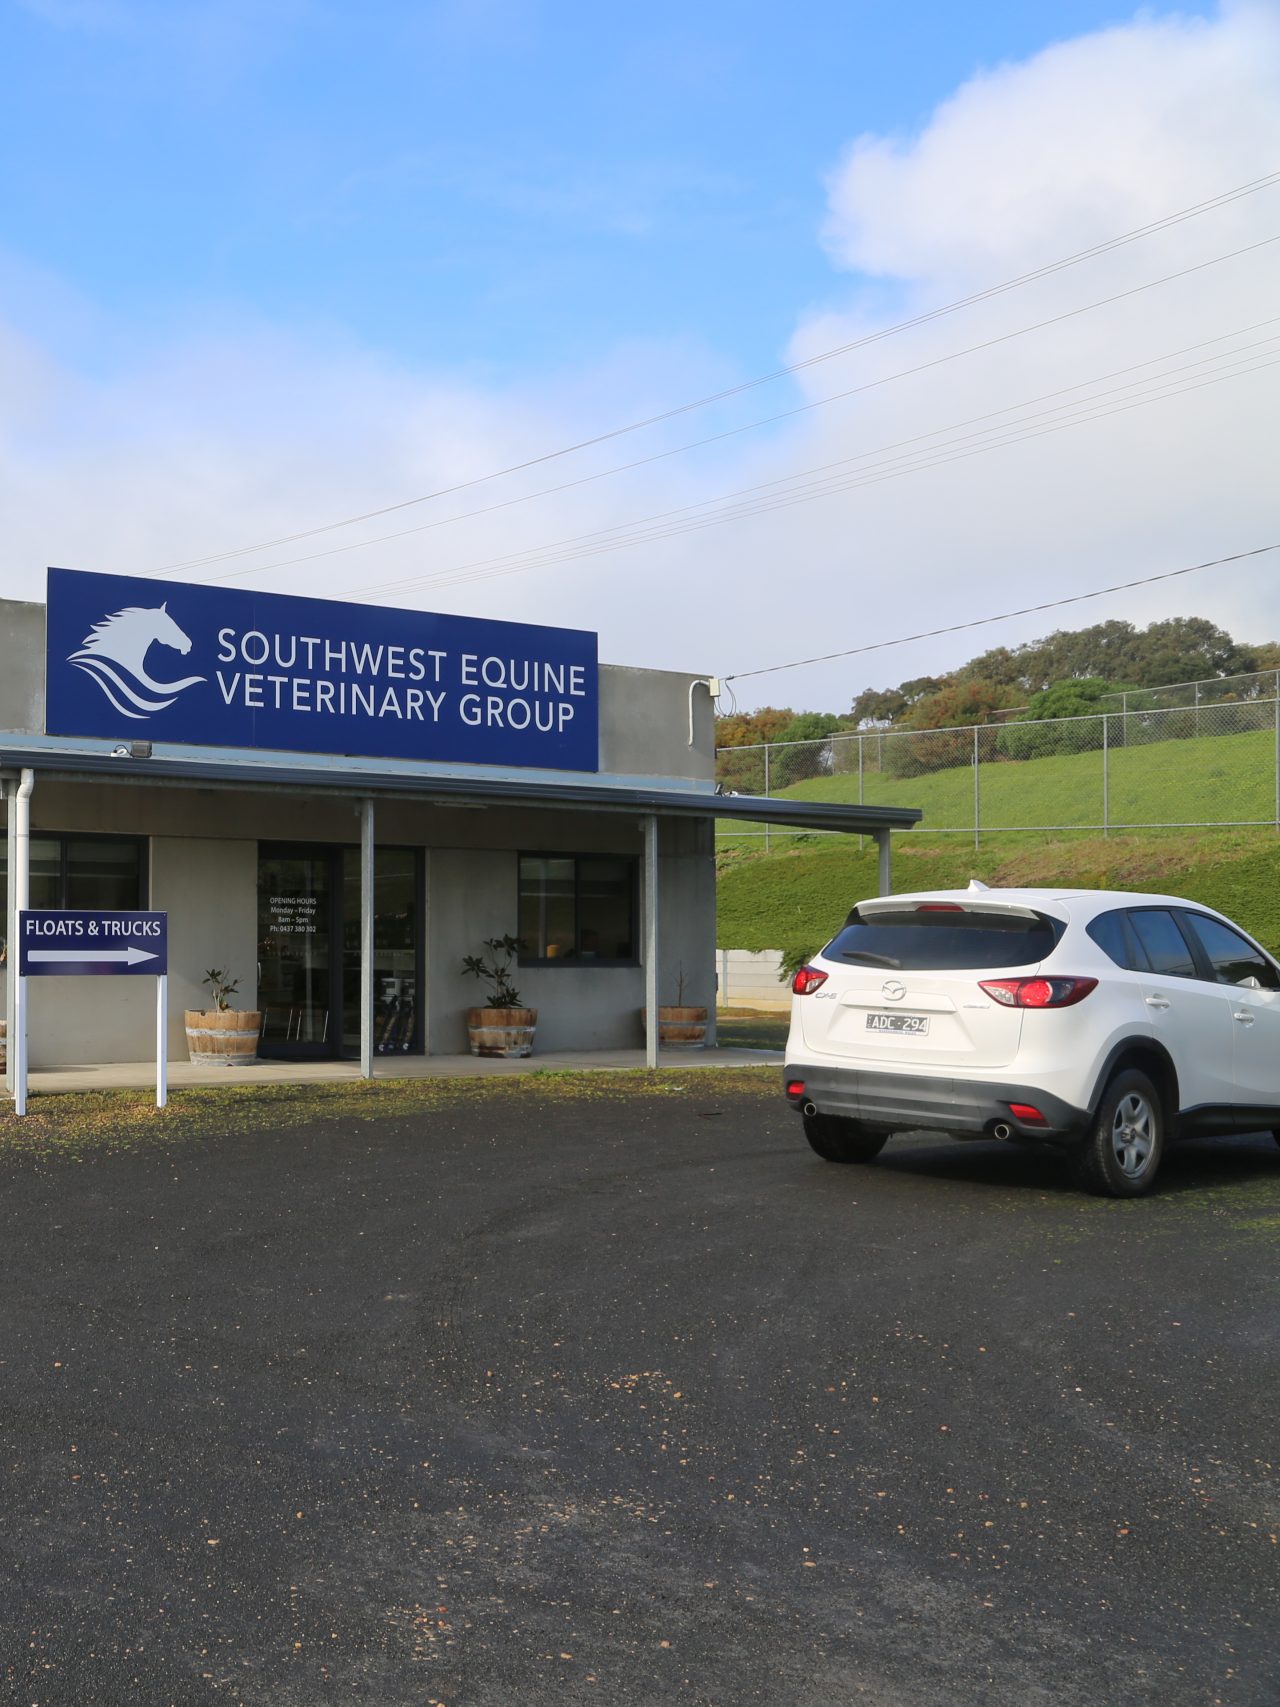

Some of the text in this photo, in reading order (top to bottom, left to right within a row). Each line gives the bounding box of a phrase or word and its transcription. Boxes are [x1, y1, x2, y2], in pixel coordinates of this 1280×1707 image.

[217, 628, 586, 697] SOUTHWEST EQUINE
[216, 670, 575, 733] VETERINARY GROUP
[270, 897, 296, 905] OPENING
[270, 907, 294, 915] Monday
[298, 907, 316, 916] Friday
[26, 919, 161, 936] FLOATS & TRUCKS
[279, 925, 294, 933] 0437
[872, 1015, 927, 1032] ADC 294
